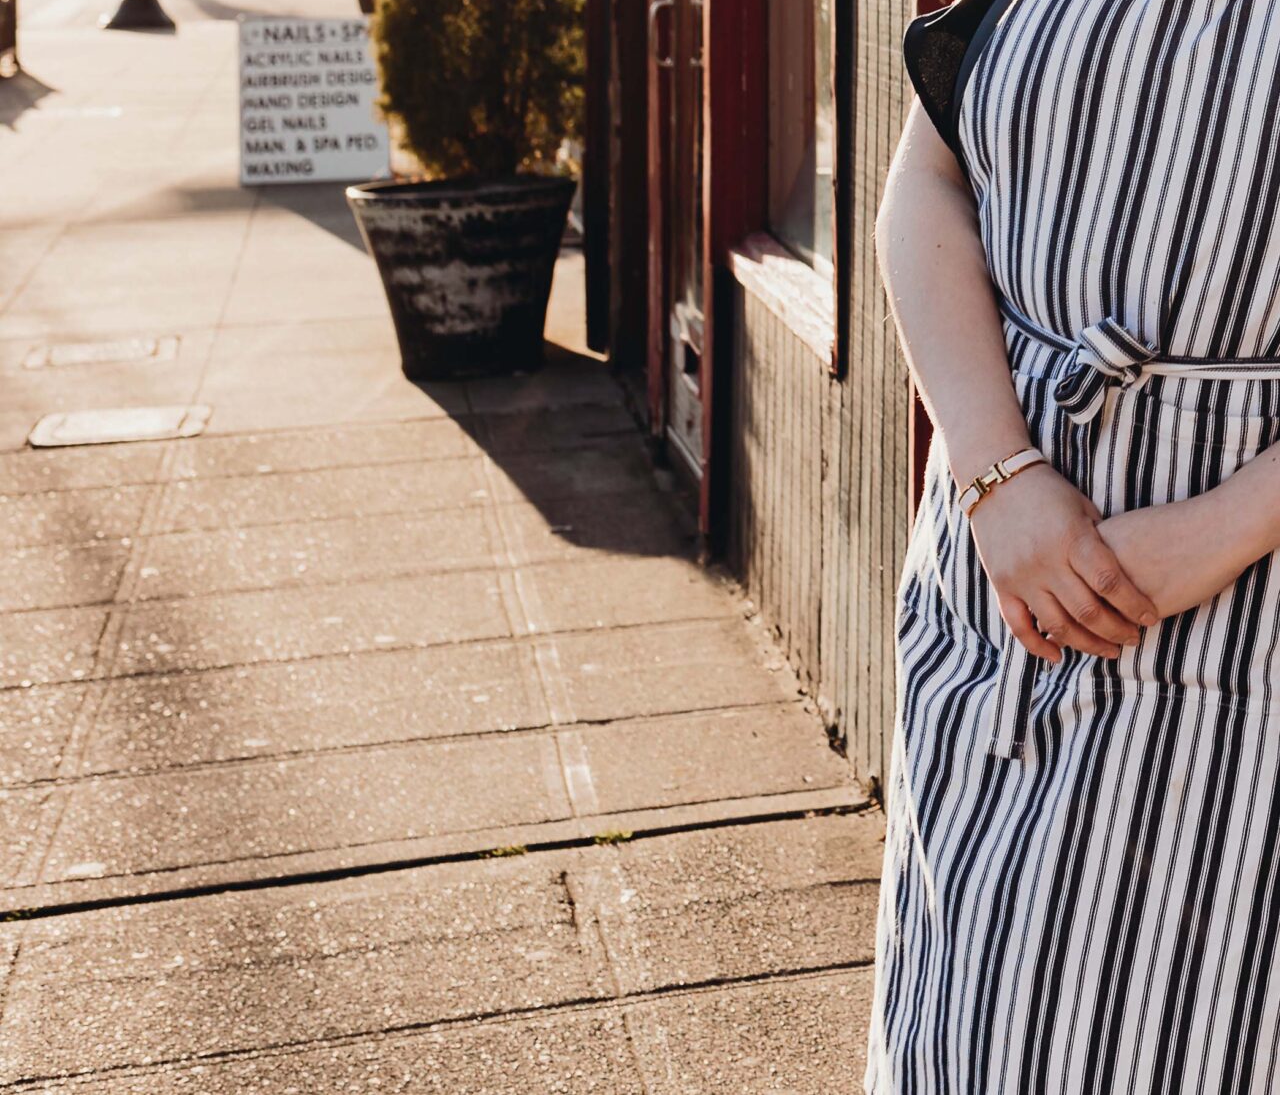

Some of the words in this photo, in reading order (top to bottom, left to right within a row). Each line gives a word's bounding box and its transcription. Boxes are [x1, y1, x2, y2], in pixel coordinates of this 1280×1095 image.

[263, 25, 326, 43] NAILS
[341, 23, 366, 42] SP
[244, 51, 312, 67] ACRYLIC
[318, 50, 363, 65] NAILS
[243, 73, 320, 88] AIRBRUSH
[326, 70, 376, 86] DESIG
[243, 95, 291, 110] HAND
[297, 92, 359, 109] DESIGN
[245, 116, 275, 133] GEL
[282, 114, 327, 131] NAILS
[313, 135, 342, 152] SPA
[245, 158, 314, 176] WAXING
